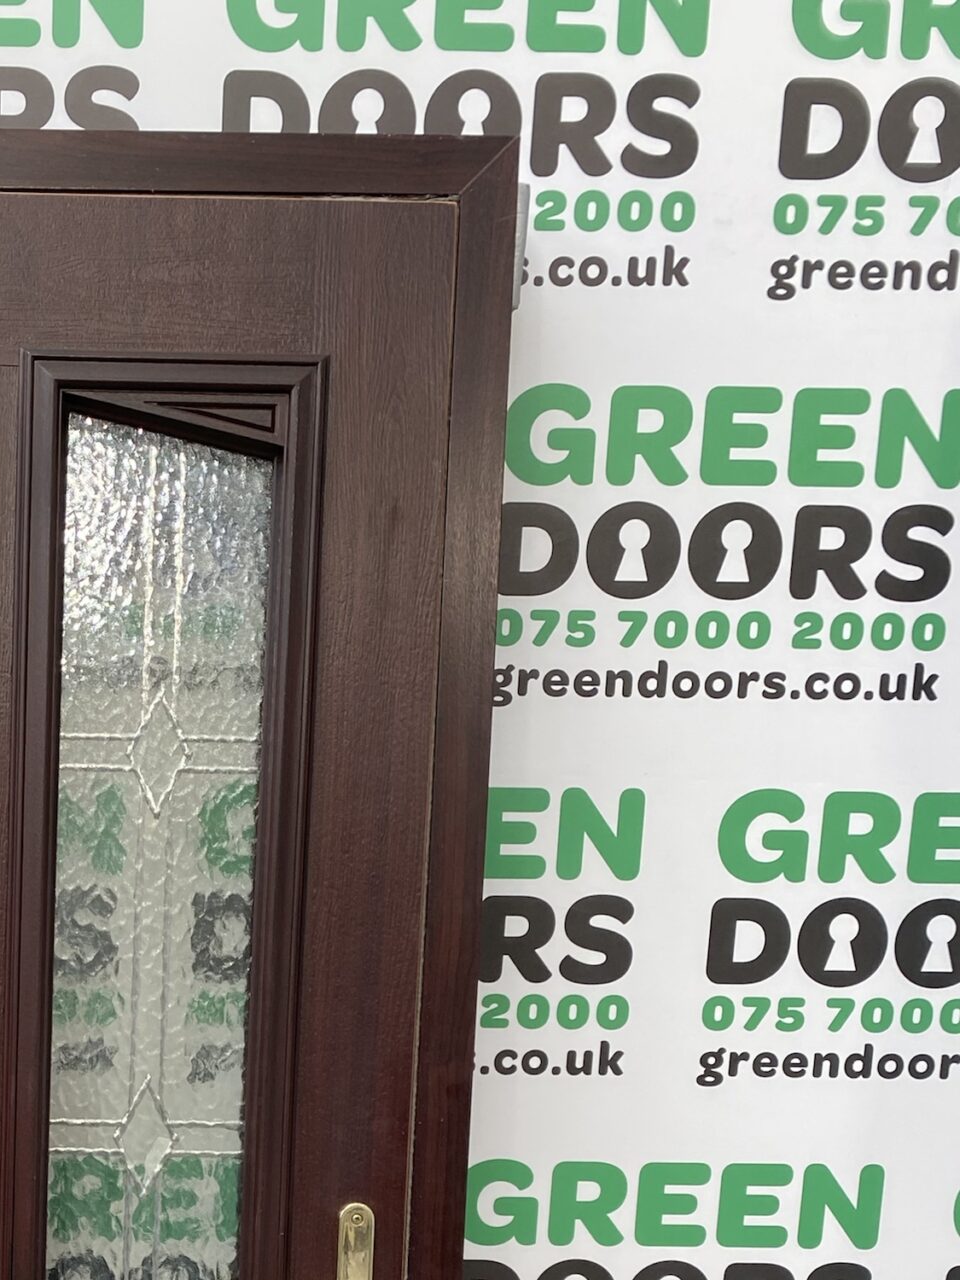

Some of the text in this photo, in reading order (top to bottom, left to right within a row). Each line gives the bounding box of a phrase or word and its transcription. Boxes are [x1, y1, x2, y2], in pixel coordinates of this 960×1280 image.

[221, 69, 700, 179] DOORS
[533, 188, 696, 233] 2000
[773, 193, 886, 236] 075
[767, 250, 960, 300] greend
[505, 383, 960, 490] GREEN
[499, 501, 954, 602] DOORS
[496, 608, 947, 652] 075 7000 2000
[493, 660, 939, 707] greendoors.co.uk
[480, 993, 630, 1031] 2000
[702, 995, 806, 1033] 075
[696, 1044, 960, 1087] greendoor
[464, 1158, 885, 1250] GREEN
